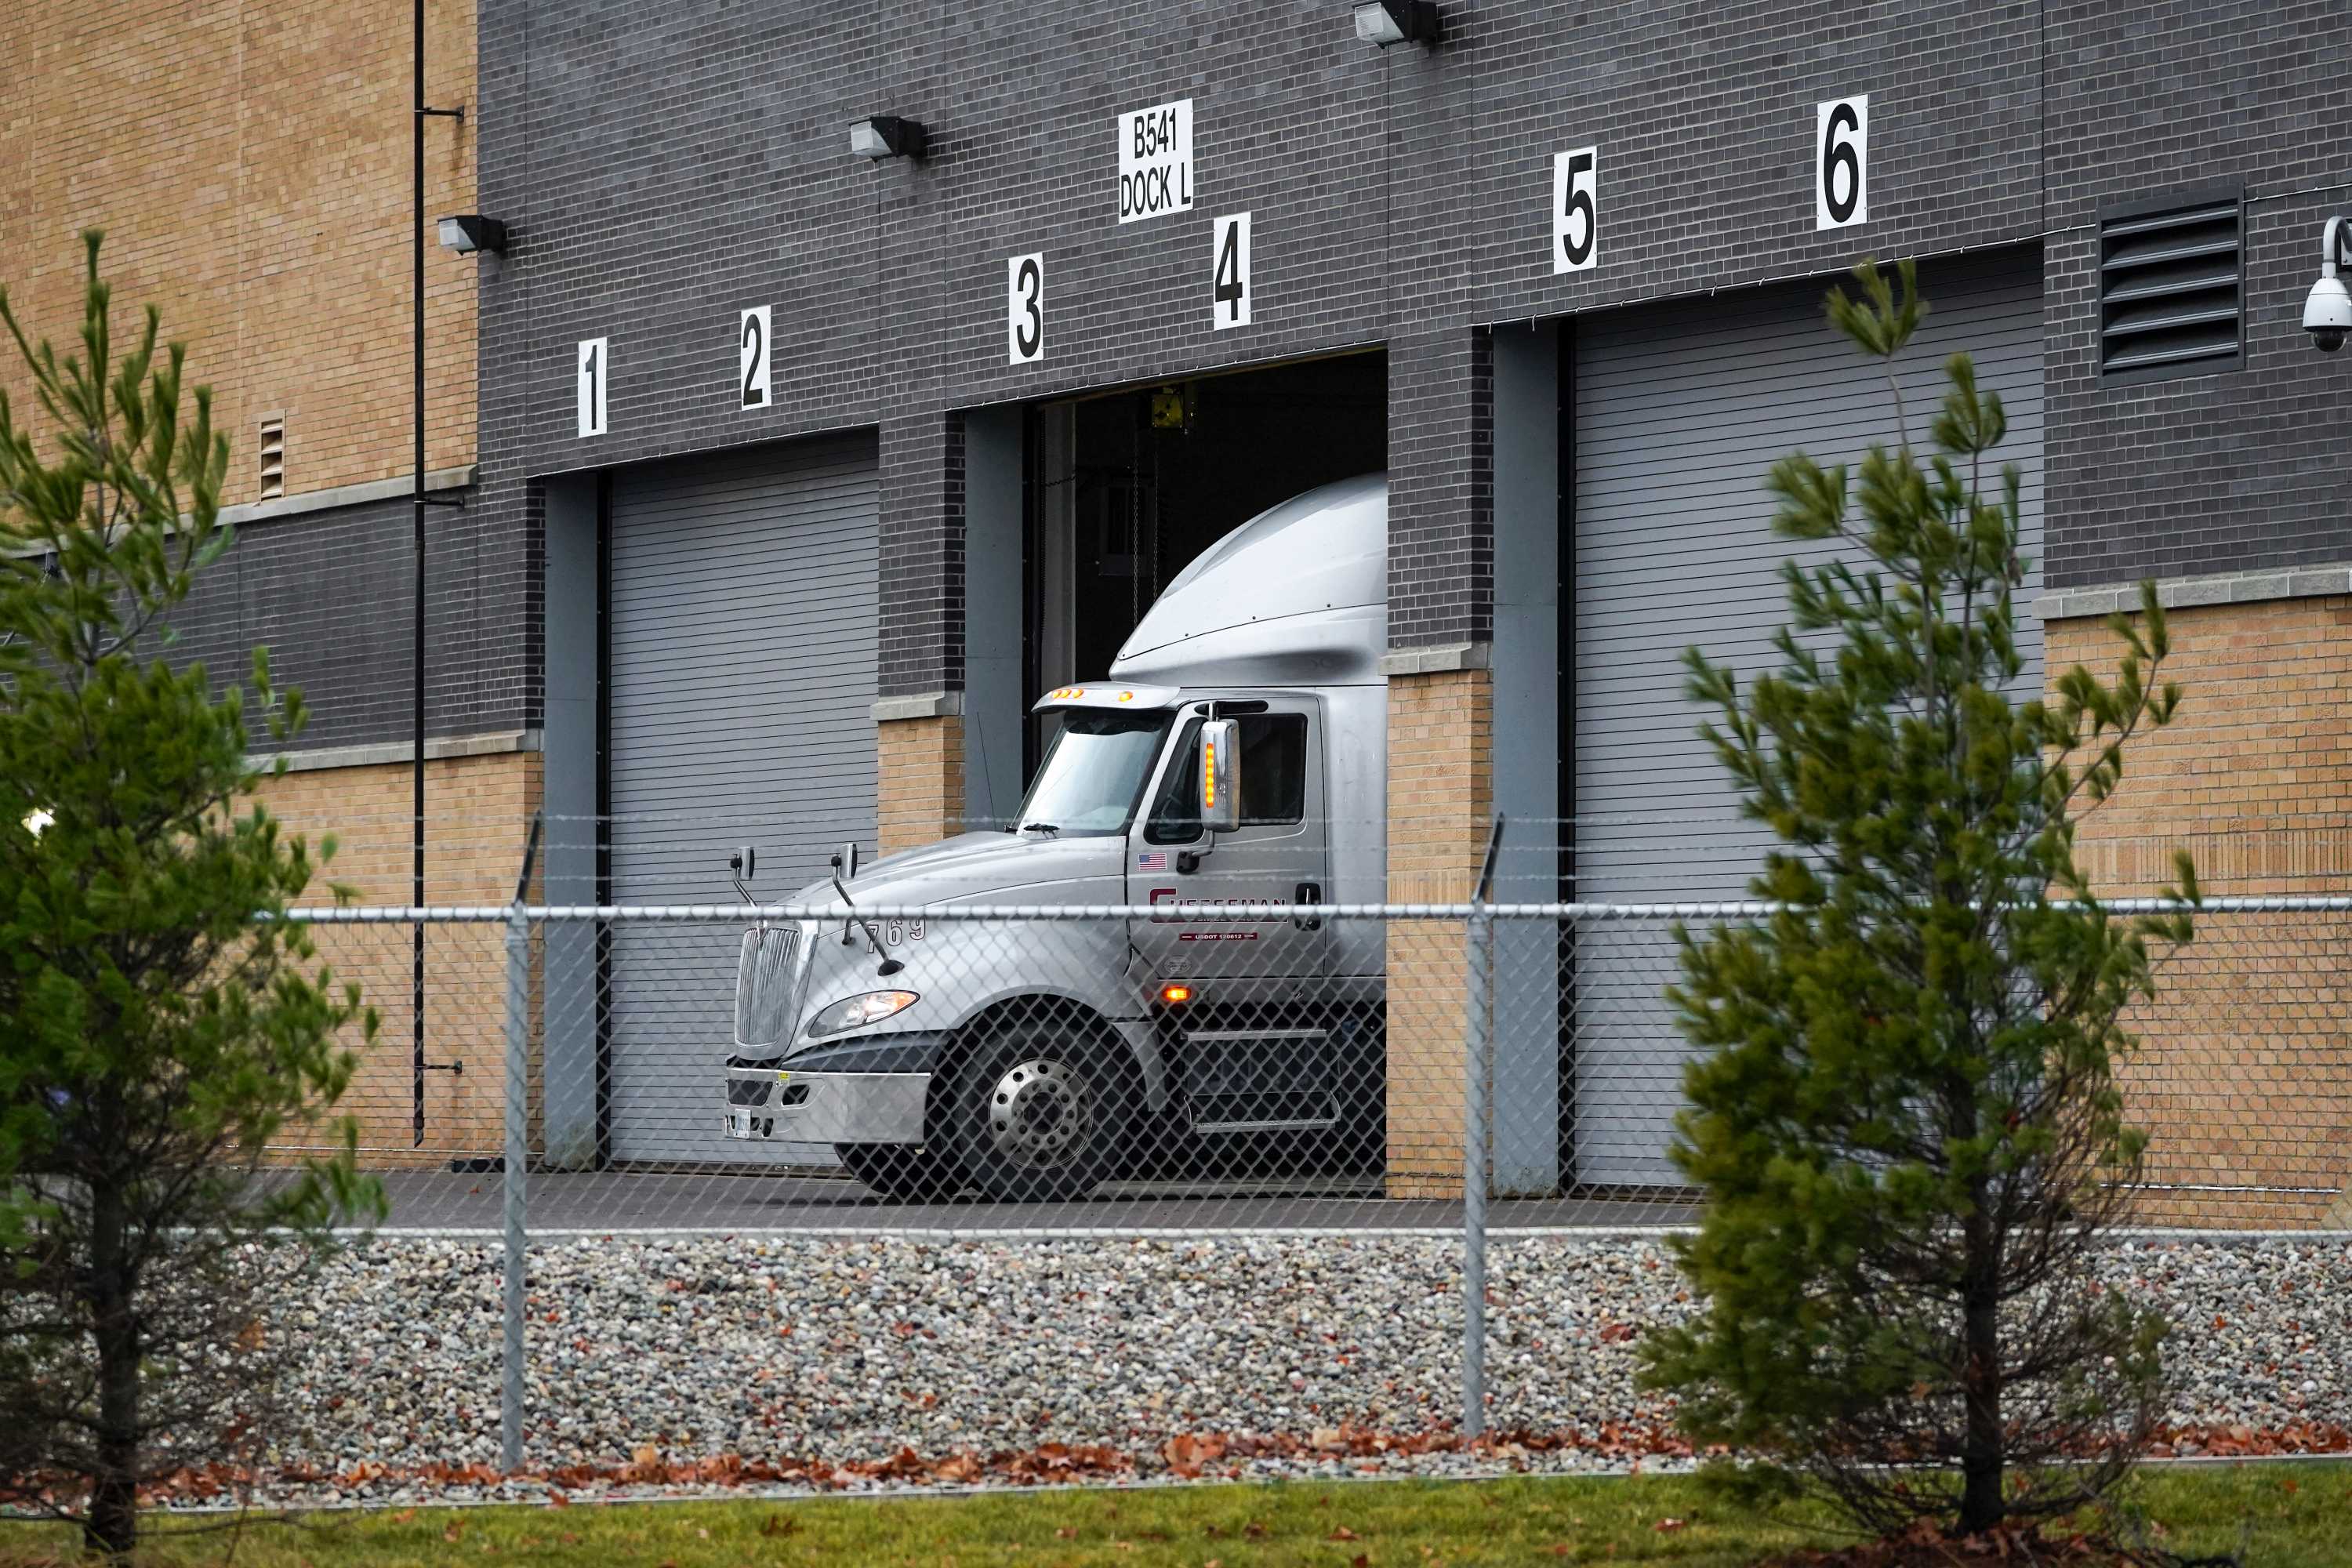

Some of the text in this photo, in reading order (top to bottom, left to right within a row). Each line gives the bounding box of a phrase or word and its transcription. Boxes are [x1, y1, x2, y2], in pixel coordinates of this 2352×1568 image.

[1134, 107, 1177, 159] B541
[1823, 103, 1860, 223] 6
[1120, 162, 1191, 217] DOCK L
[1563, 152, 1595, 266] 5
[1016, 258, 1041, 358] 3
[1214, 220, 1243, 321] 4
[585, 344, 597, 430] 1
[742, 314, 764, 406] 2
[866, 917, 927, 953] 769
